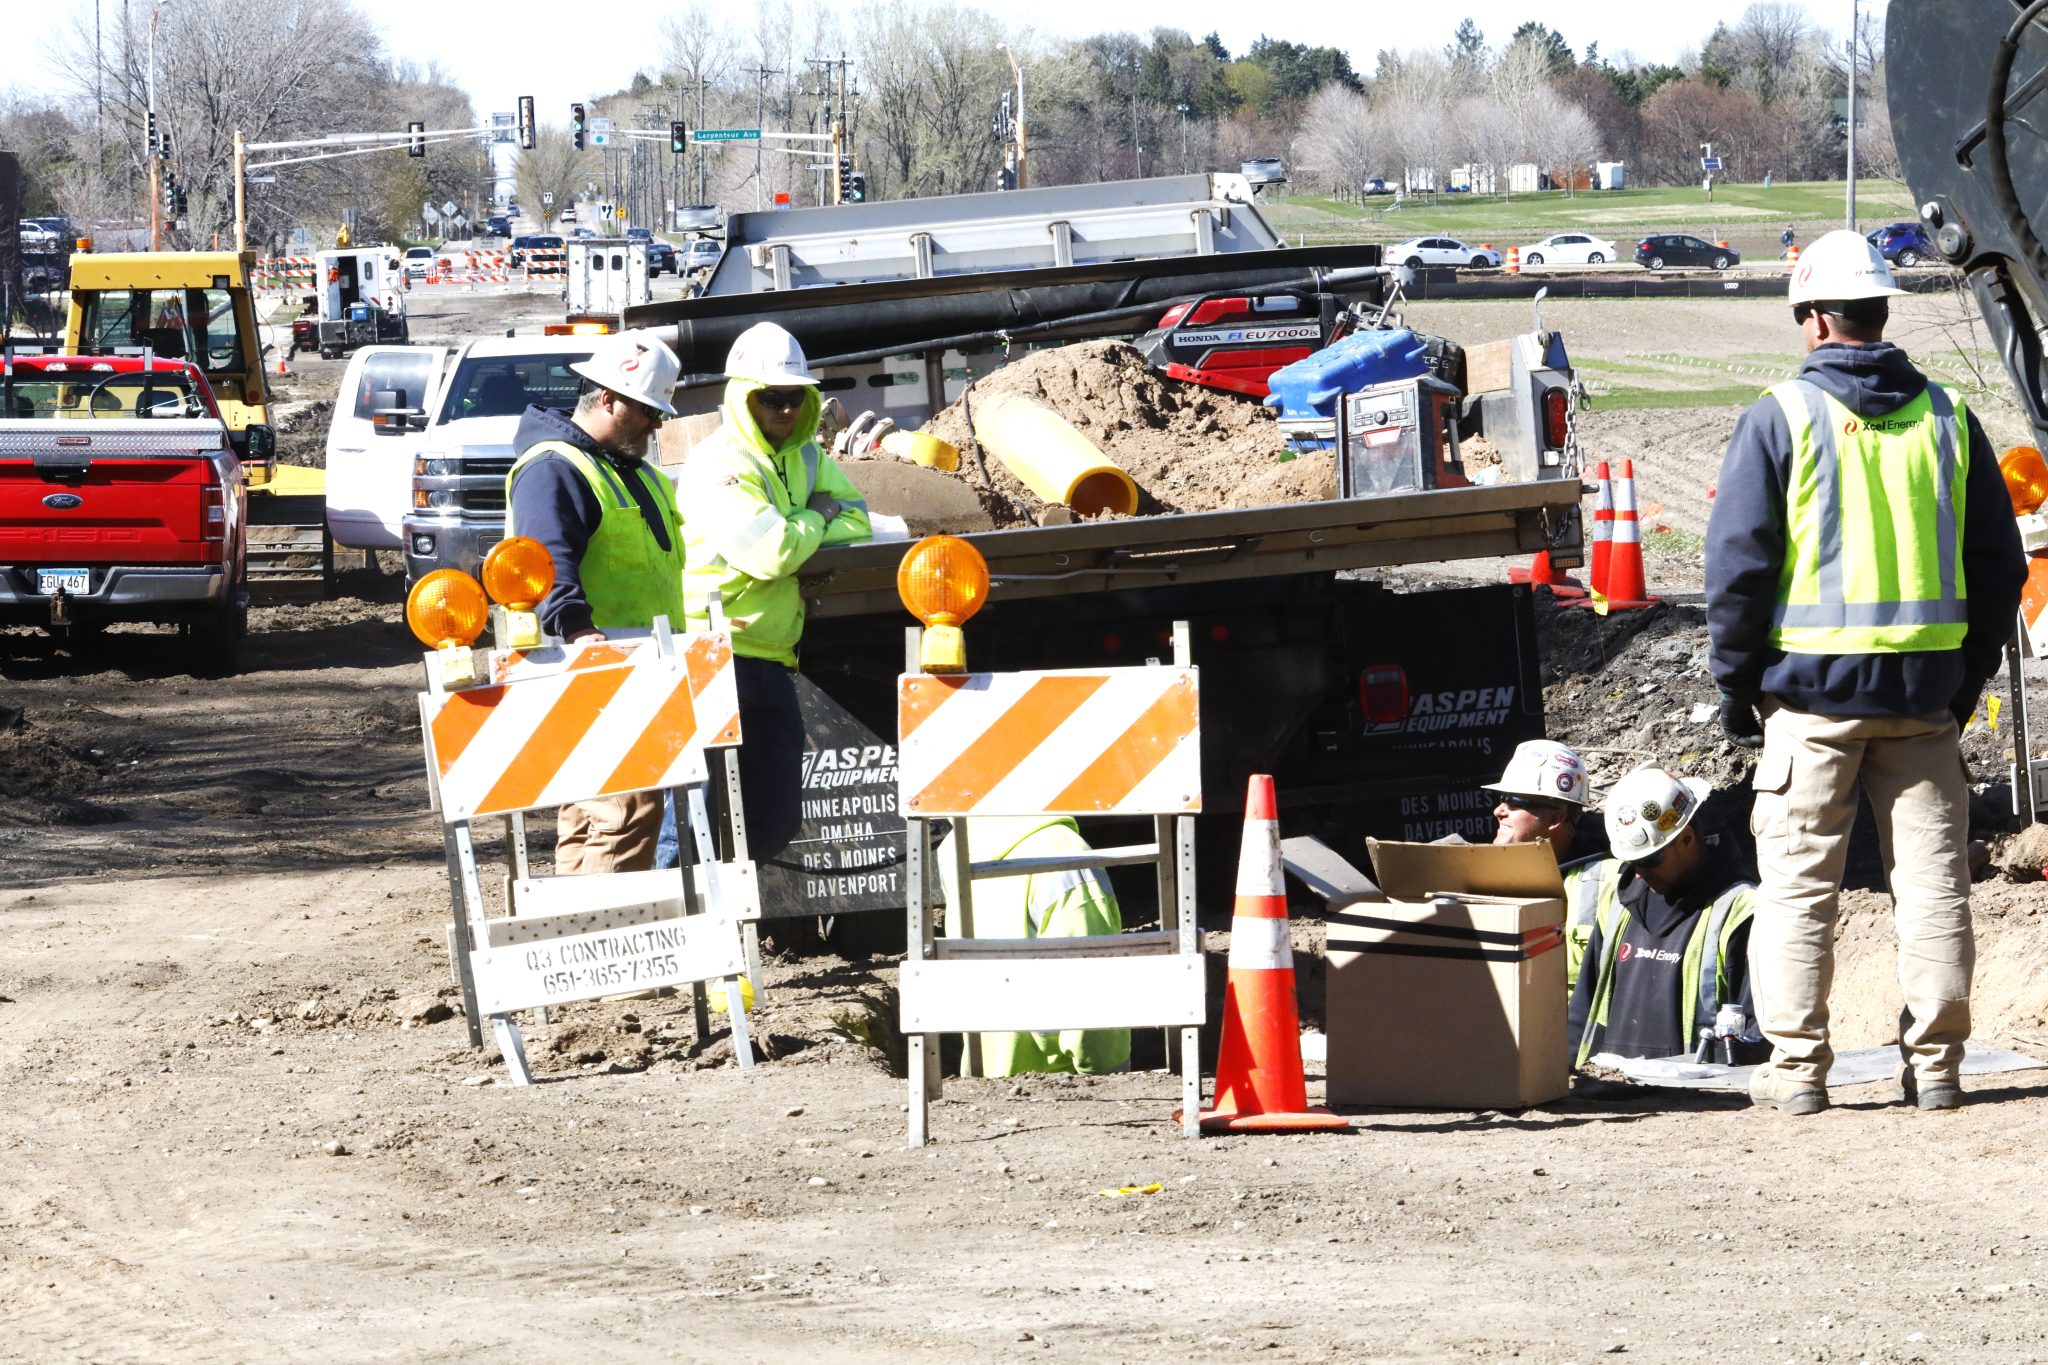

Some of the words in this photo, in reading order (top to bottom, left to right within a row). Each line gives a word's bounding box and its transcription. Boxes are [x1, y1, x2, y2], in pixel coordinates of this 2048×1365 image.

[697, 131, 740, 139] Larpenteur
[1178, 334, 1222, 343] HONDA
[1862, 421, 1886, 432] Xcel
[1886, 419, 1920, 431] Energy
[51, 496, 74, 506] Ford
[41, 575, 60, 589] EGU
[67, 575, 86, 589] 467
[1412, 686, 1515, 715] ASPEN
[1406, 708, 1510, 734] EQUIPMENT
[815, 745, 899, 771] ASPE
[809, 766, 900, 790] EQUIPMEN
[1401, 796, 1429, 816] DES
[1437, 790, 1494, 813] MOINES
[821, 822, 875, 844] OMAHA
[1404, 816, 1495, 842] DAVENPORT
[803, 852, 833, 872] DES
[841, 847, 897, 869] MOINES
[807, 872, 897, 899] DAVENPORT
[526, 950, 553, 971] Q3
[560, 926, 686, 966] CONTRACTING
[543, 954, 679, 995] 651-365-7355
